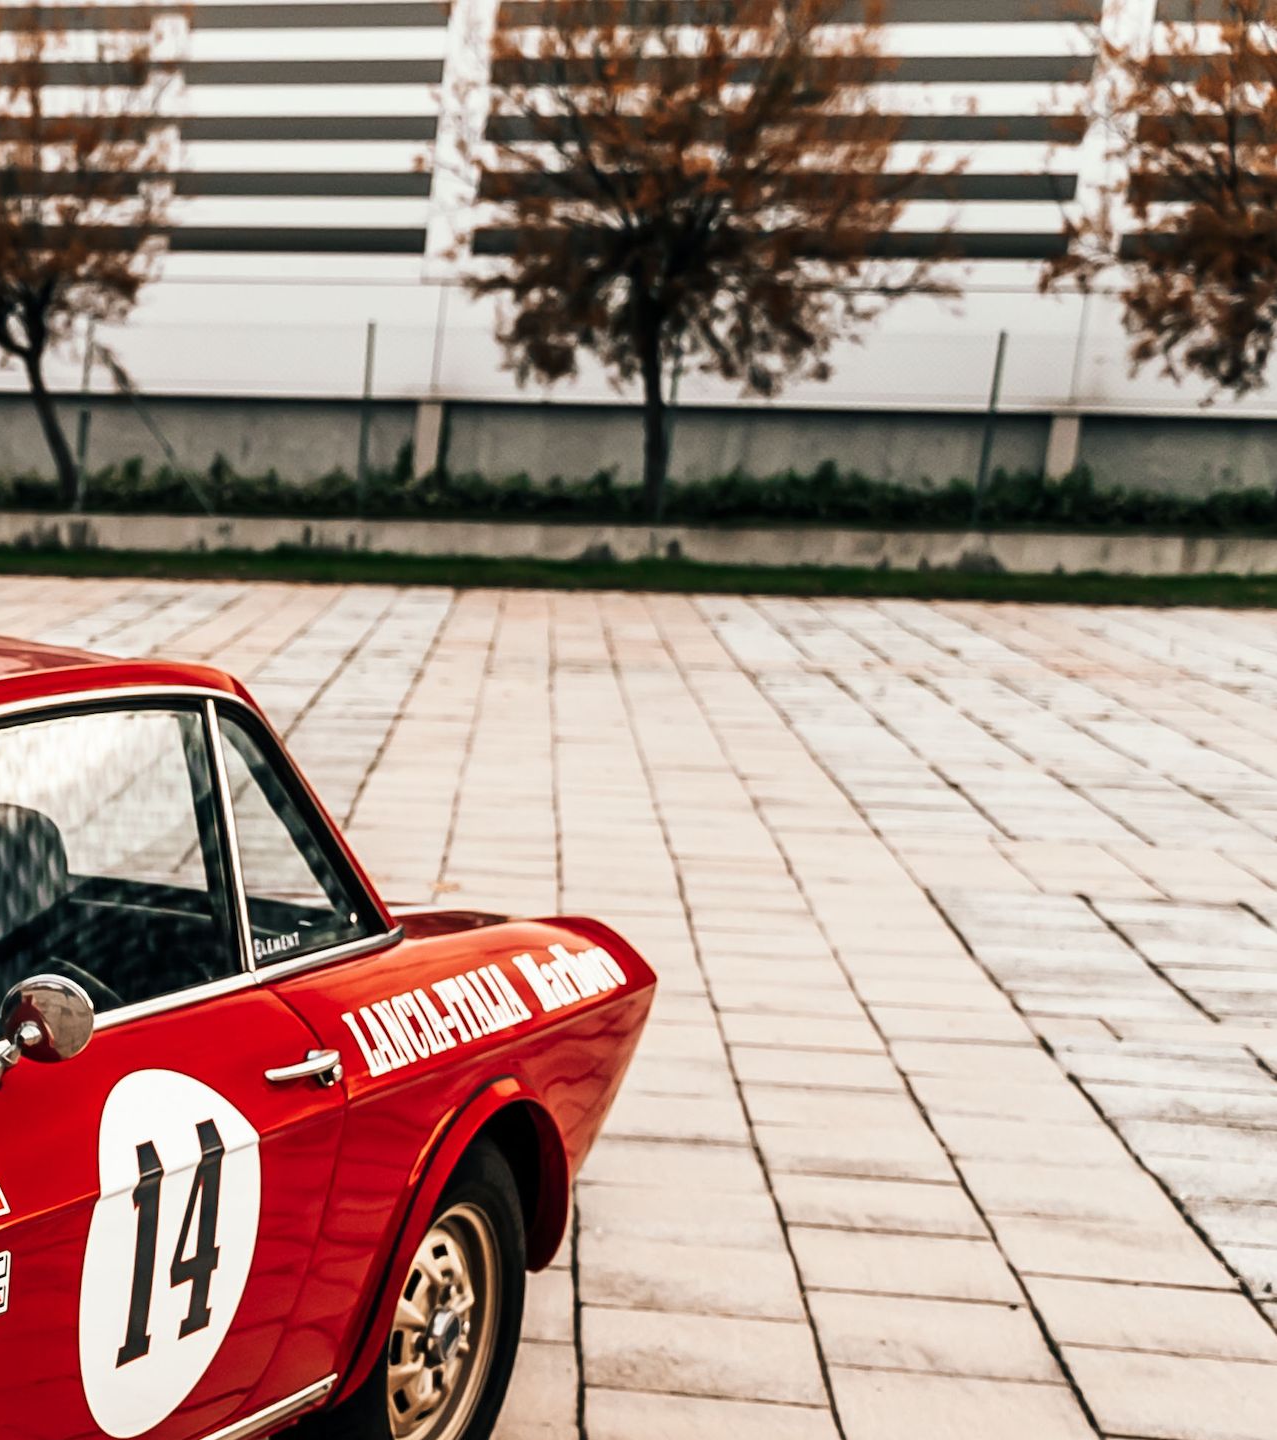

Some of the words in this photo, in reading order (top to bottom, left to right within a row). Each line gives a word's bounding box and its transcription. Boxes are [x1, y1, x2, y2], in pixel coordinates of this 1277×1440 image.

[341, 963, 533, 1078] LANCIA-ITALIA
[512, 943, 629, 1013] Marlboro
[115, 1118, 226, 1370] 14
